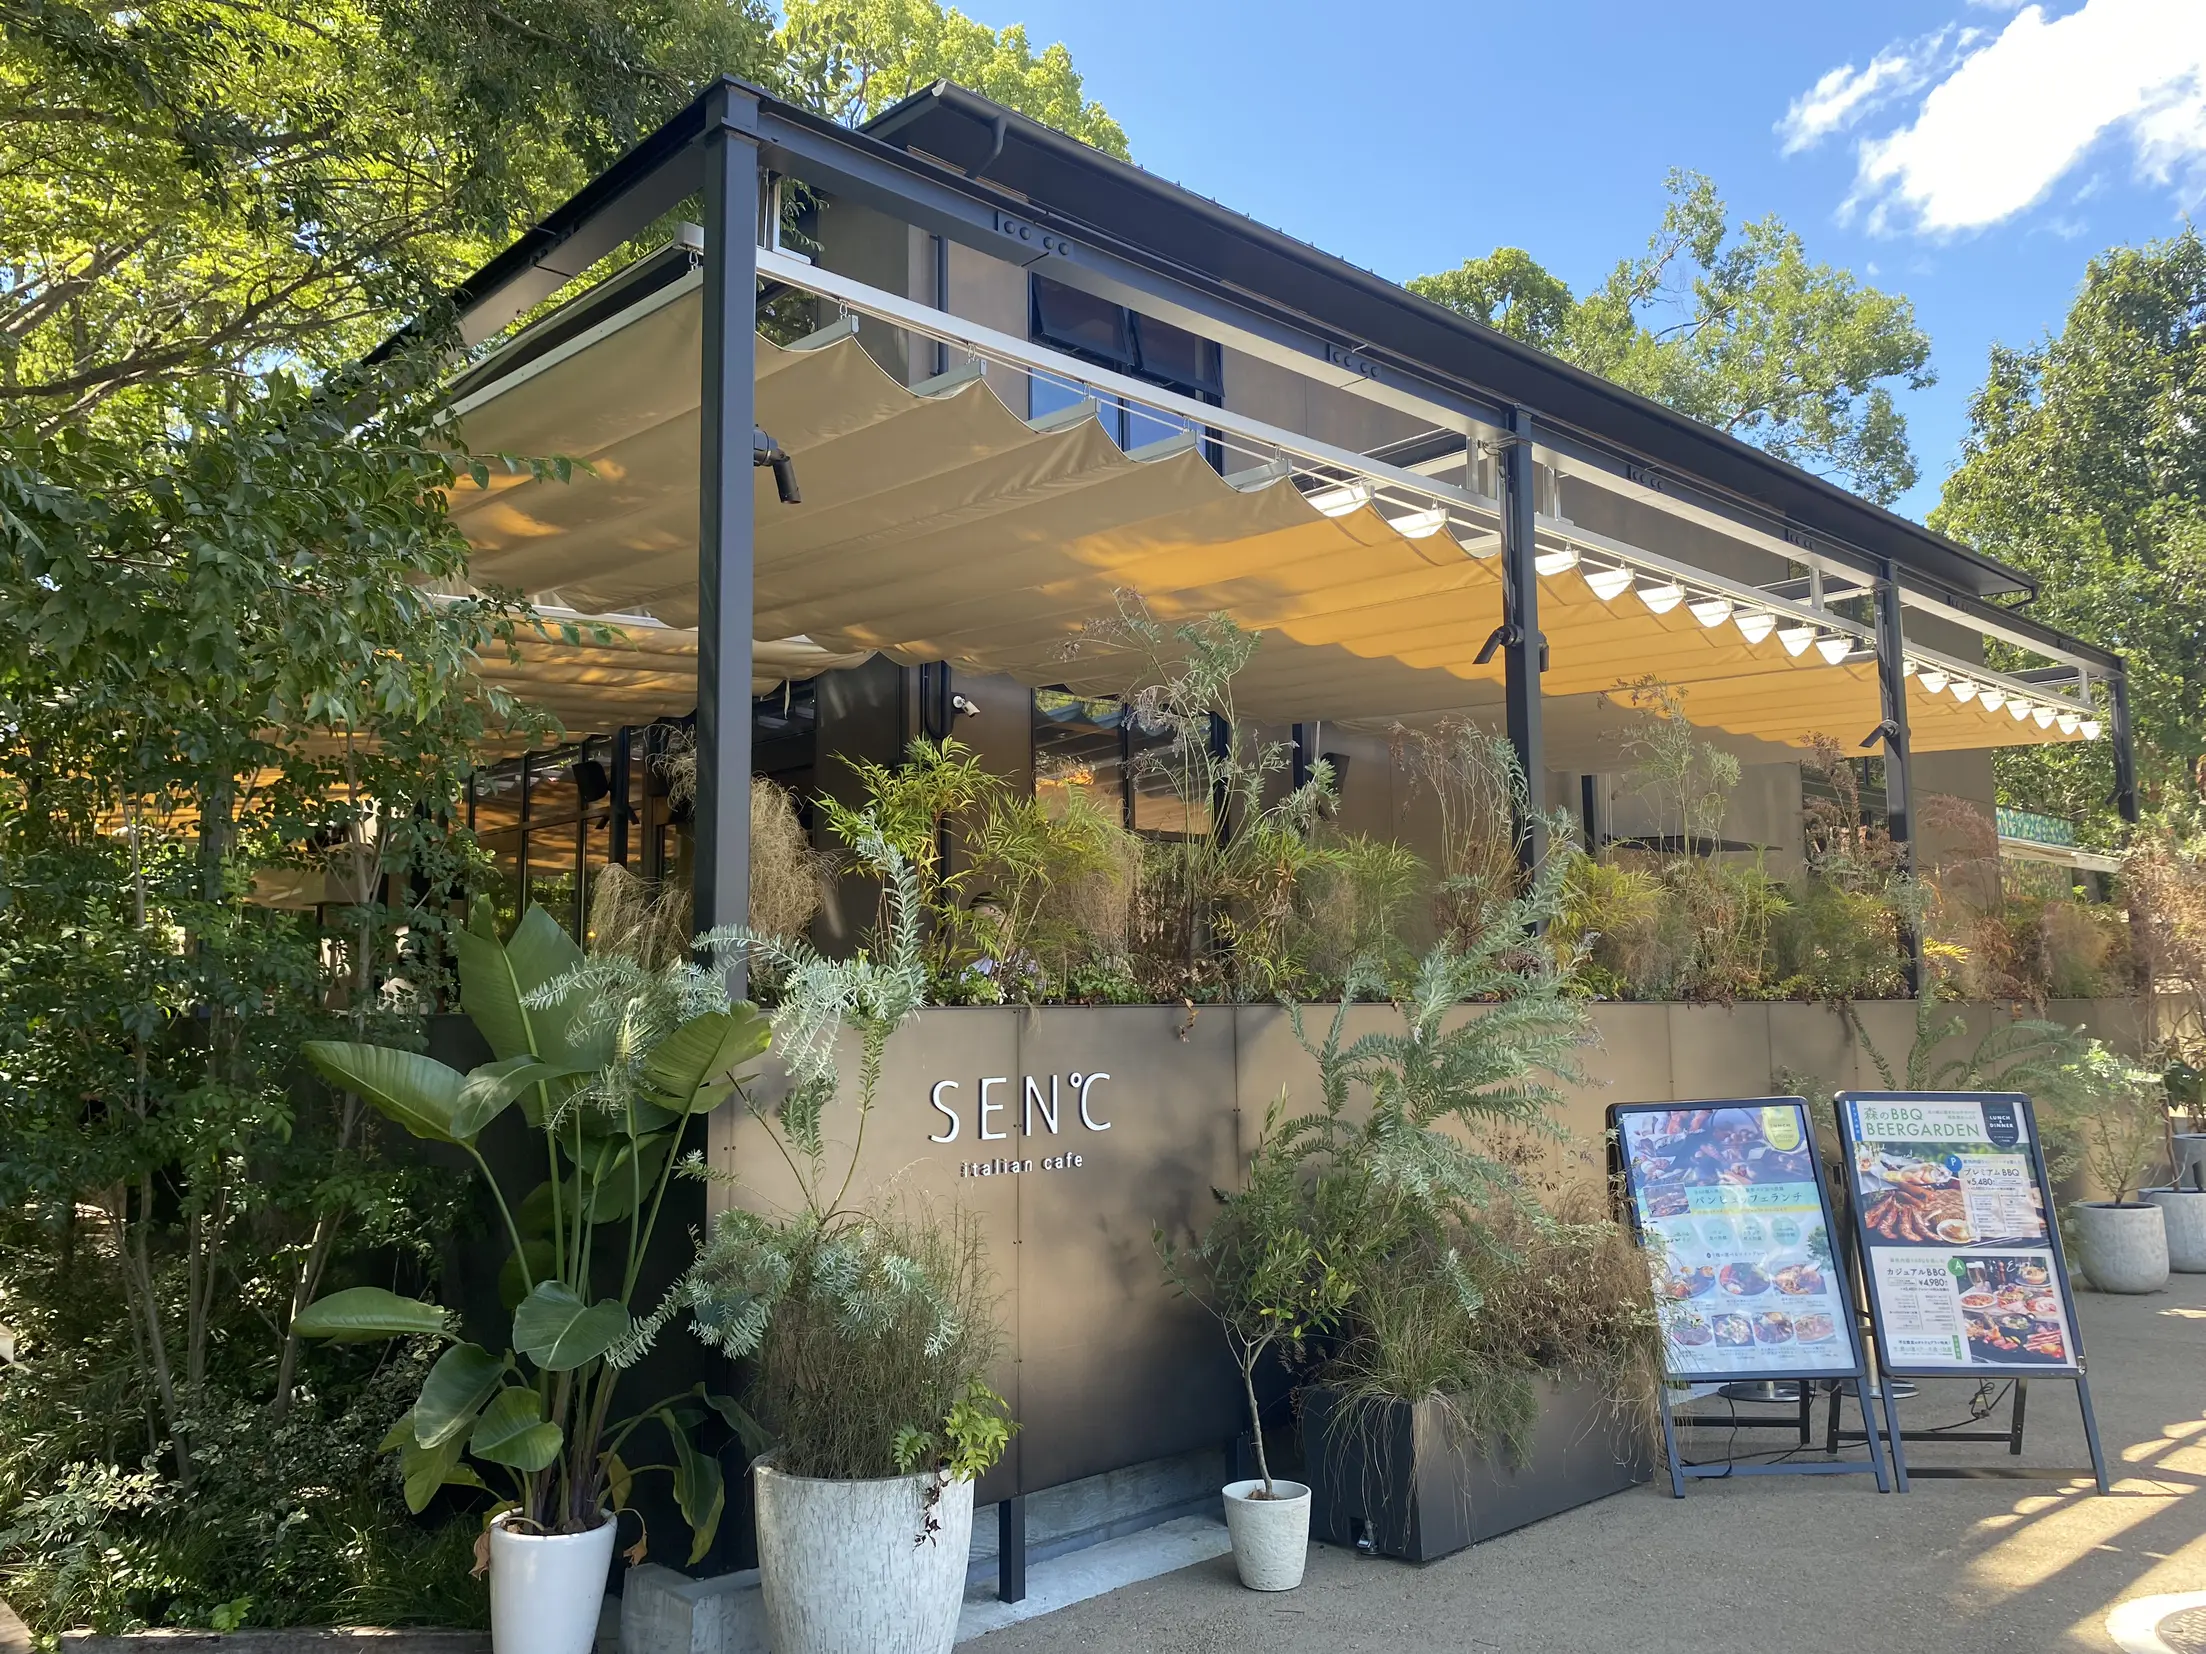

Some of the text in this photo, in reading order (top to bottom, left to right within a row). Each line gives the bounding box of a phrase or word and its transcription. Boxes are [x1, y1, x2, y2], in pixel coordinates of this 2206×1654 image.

[1864, 1106, 1923, 1121] 森のBBQ
[1866, 1122, 1980, 1137] BEERGARDEN
[961, 1151, 1083, 1178] italian cafe
[1950, 1157, 1957, 1166] P
[1955, 1261, 1963, 1270] A
[1887, 1268, 1947, 1277] カジュアルBBQ
